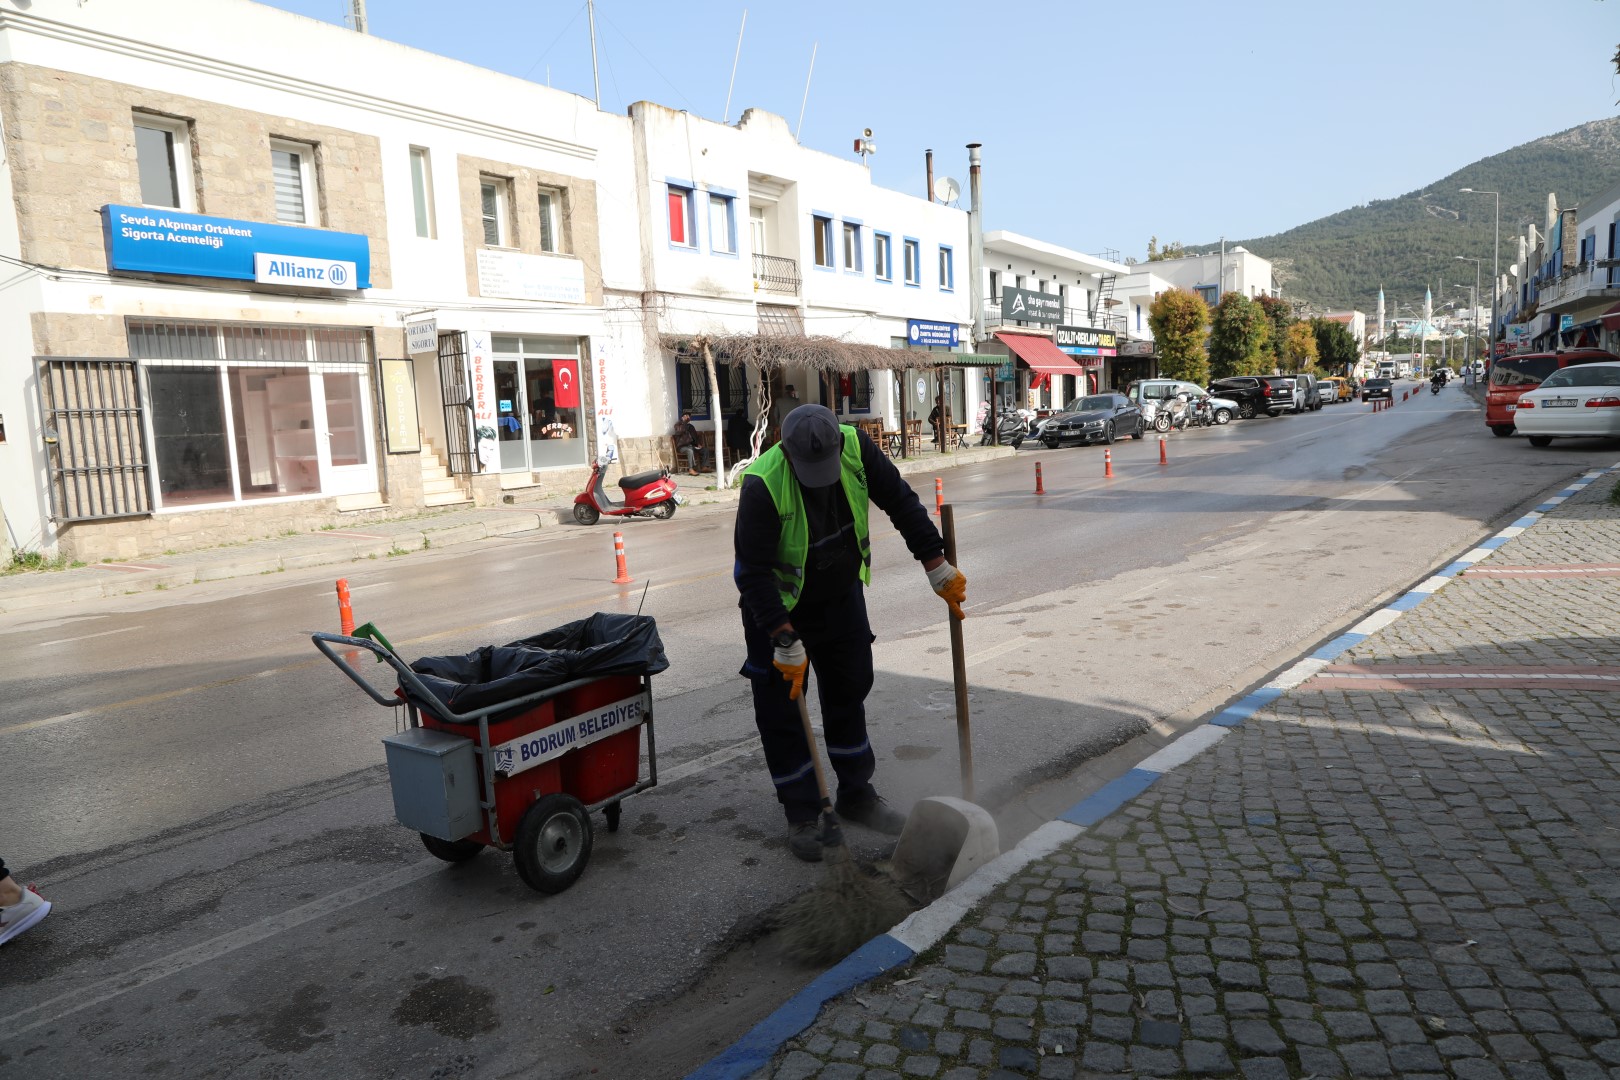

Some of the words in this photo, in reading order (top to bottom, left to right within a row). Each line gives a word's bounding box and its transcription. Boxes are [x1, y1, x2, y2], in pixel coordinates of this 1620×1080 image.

[120, 214, 156, 227] Sevda
[159, 218, 203, 232] Akpınar
[204, 224, 252, 238] Ortakent
[121, 227, 164, 241] Sigorta
[167, 232, 223, 248] Acenteliği
[268, 260, 324, 280] Allianz
[408, 321, 437, 336] ORTAKENT
[1098, 333, 1116, 347] TABELA
[474, 356, 486, 409] BERBER
[598, 359, 608, 406] BERBER
[474, 410, 492, 420] ALİ
[598, 407, 612, 416] ALİ
[541, 422, 573, 435] BERBER
[520, 725, 576, 762] BODRUM
